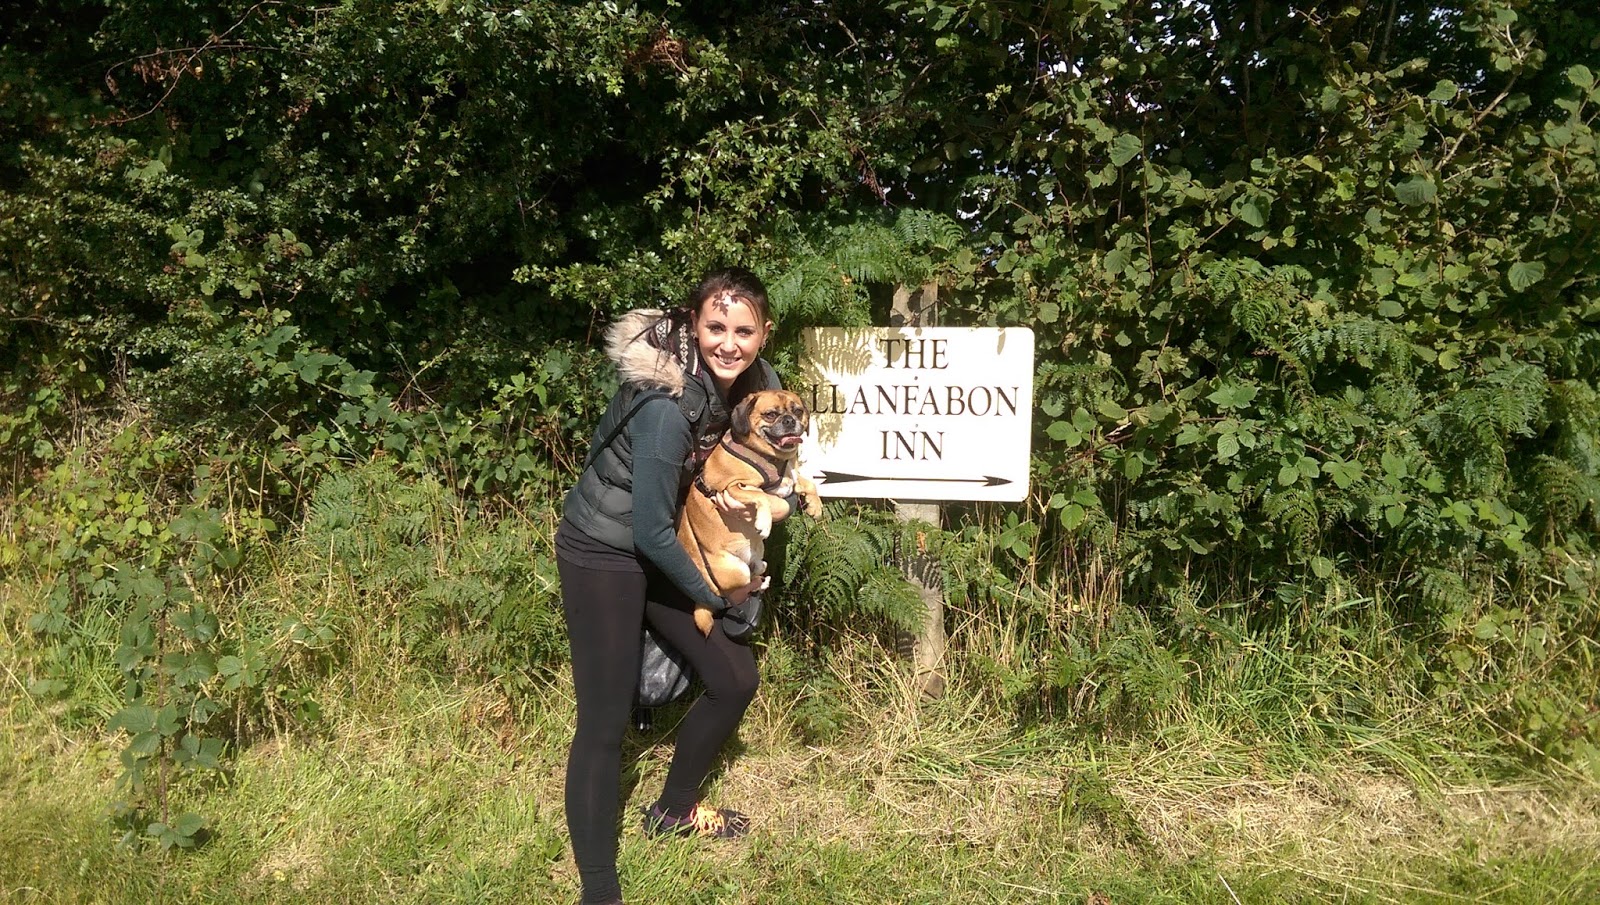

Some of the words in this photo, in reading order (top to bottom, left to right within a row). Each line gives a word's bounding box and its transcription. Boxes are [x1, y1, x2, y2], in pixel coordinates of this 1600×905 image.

[880, 339, 949, 370] THE
[811, 384, 1020, 417] LLANFABON
[880, 430, 945, 461] INN
